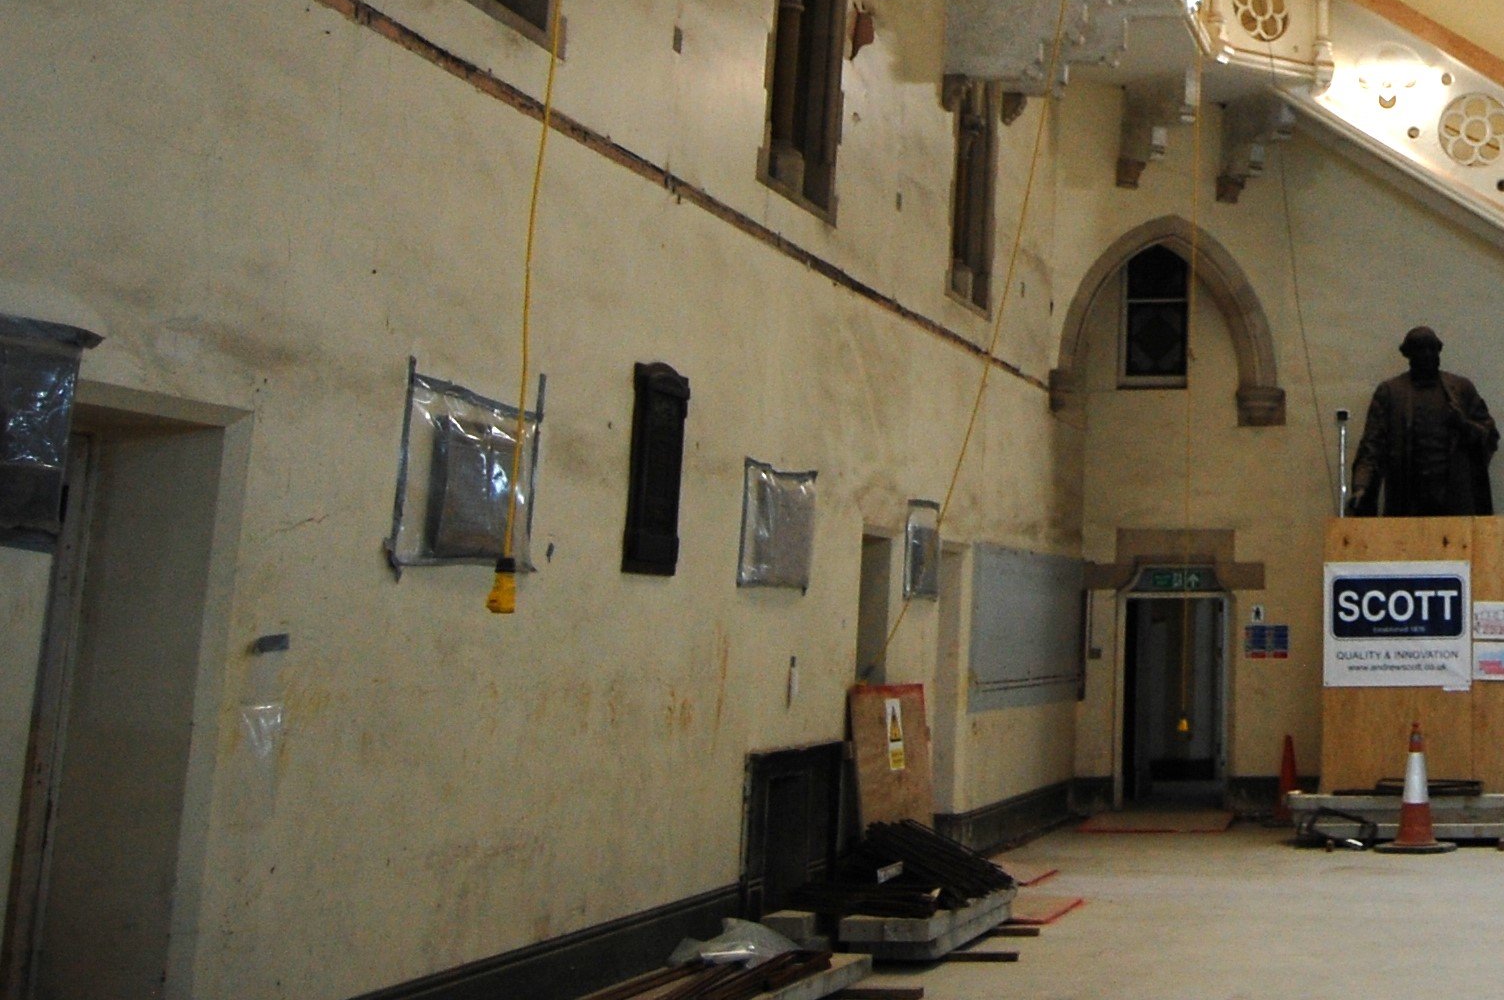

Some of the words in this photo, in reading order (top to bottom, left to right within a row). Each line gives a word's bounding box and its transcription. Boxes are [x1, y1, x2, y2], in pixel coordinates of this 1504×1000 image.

[1337, 590, 1458, 622] SCOTT
[1336, 650, 1381, 661] QUALITY
[1384, 650, 1391, 660] &
[1394, 649, 1459, 660] INNOVATION
[1347, 662, 1447, 672] www.andrewscott.co.uk
